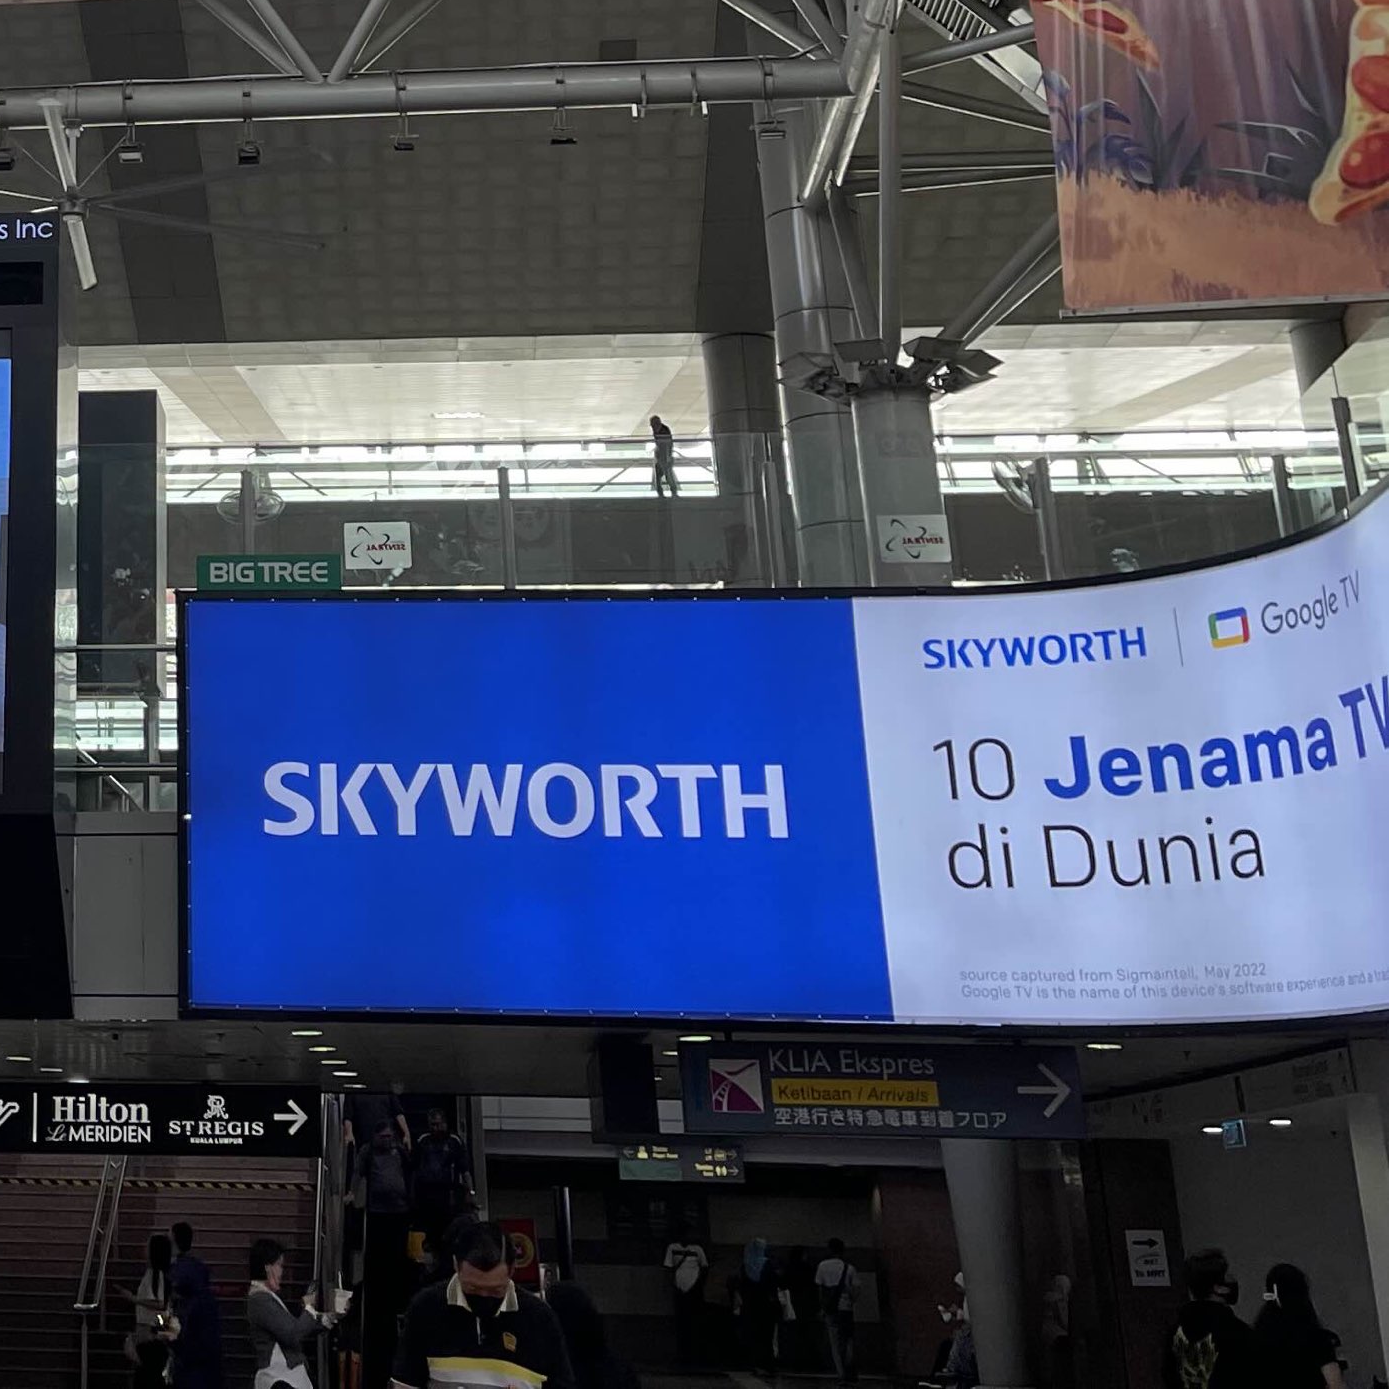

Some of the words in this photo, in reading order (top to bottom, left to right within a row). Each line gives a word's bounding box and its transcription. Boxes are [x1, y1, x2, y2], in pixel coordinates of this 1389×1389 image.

[16, 218, 53, 239] Inc
[1261, 584, 1339, 635] Google
[1339, 569, 1360, 609] TV
[923, 626, 1147, 669] SKYWORTH
[932, 737, 1015, 801] 10
[1043, 716, 1338, 800] Jenama
[1338, 674, 1389, 760] TV
[263, 761, 789, 839] SKYWORTH
[947, 823, 1015, 890] di
[1042, 816, 1266, 890] Dunia
[960, 969, 1008, 982] source
[1011, 968, 1076, 984] captured
[1079, 968, 1113, 982] from
[1204, 966, 1230, 980] May
[1234, 962, 1266, 977] 2022
[961, 984, 1011, 1001] Google
[1014, 985, 1033, 999] TV
[1036, 985, 1049, 999] is
[1052, 985, 1076, 999] the
[1079, 987, 1120, 999] name
[1123, 984, 1138, 999] of
[1141, 984, 1168, 999] this
[1229, 981, 1284, 995] software
[767, 1048, 832, 1073] KLIA
[839, 1049, 936, 1080] Ekspres
[51, 1093, 151, 1124] Hilton
[777, 1085, 852, 1102] Ketibaan
[867, 1086, 930, 1103] Arrivals
[198, 1120, 265, 1137] REGIS
